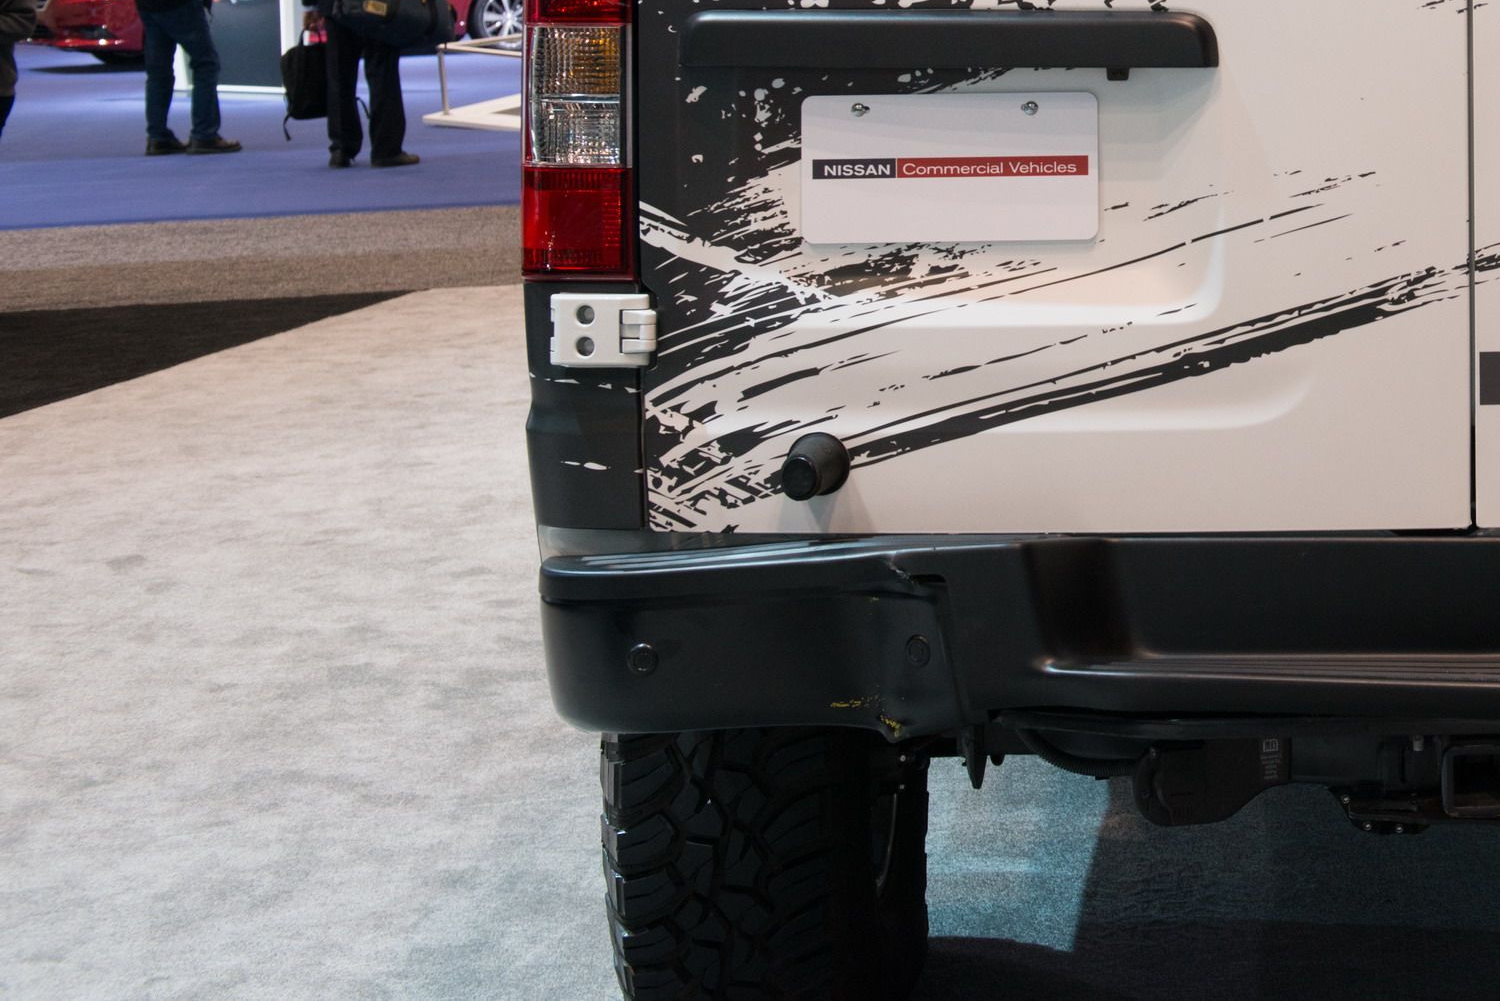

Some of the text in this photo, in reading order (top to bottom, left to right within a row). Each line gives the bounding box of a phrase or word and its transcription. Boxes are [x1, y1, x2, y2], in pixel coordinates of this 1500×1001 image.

[823, 161, 1077, 177] NISSAN Commercial Vehicles
